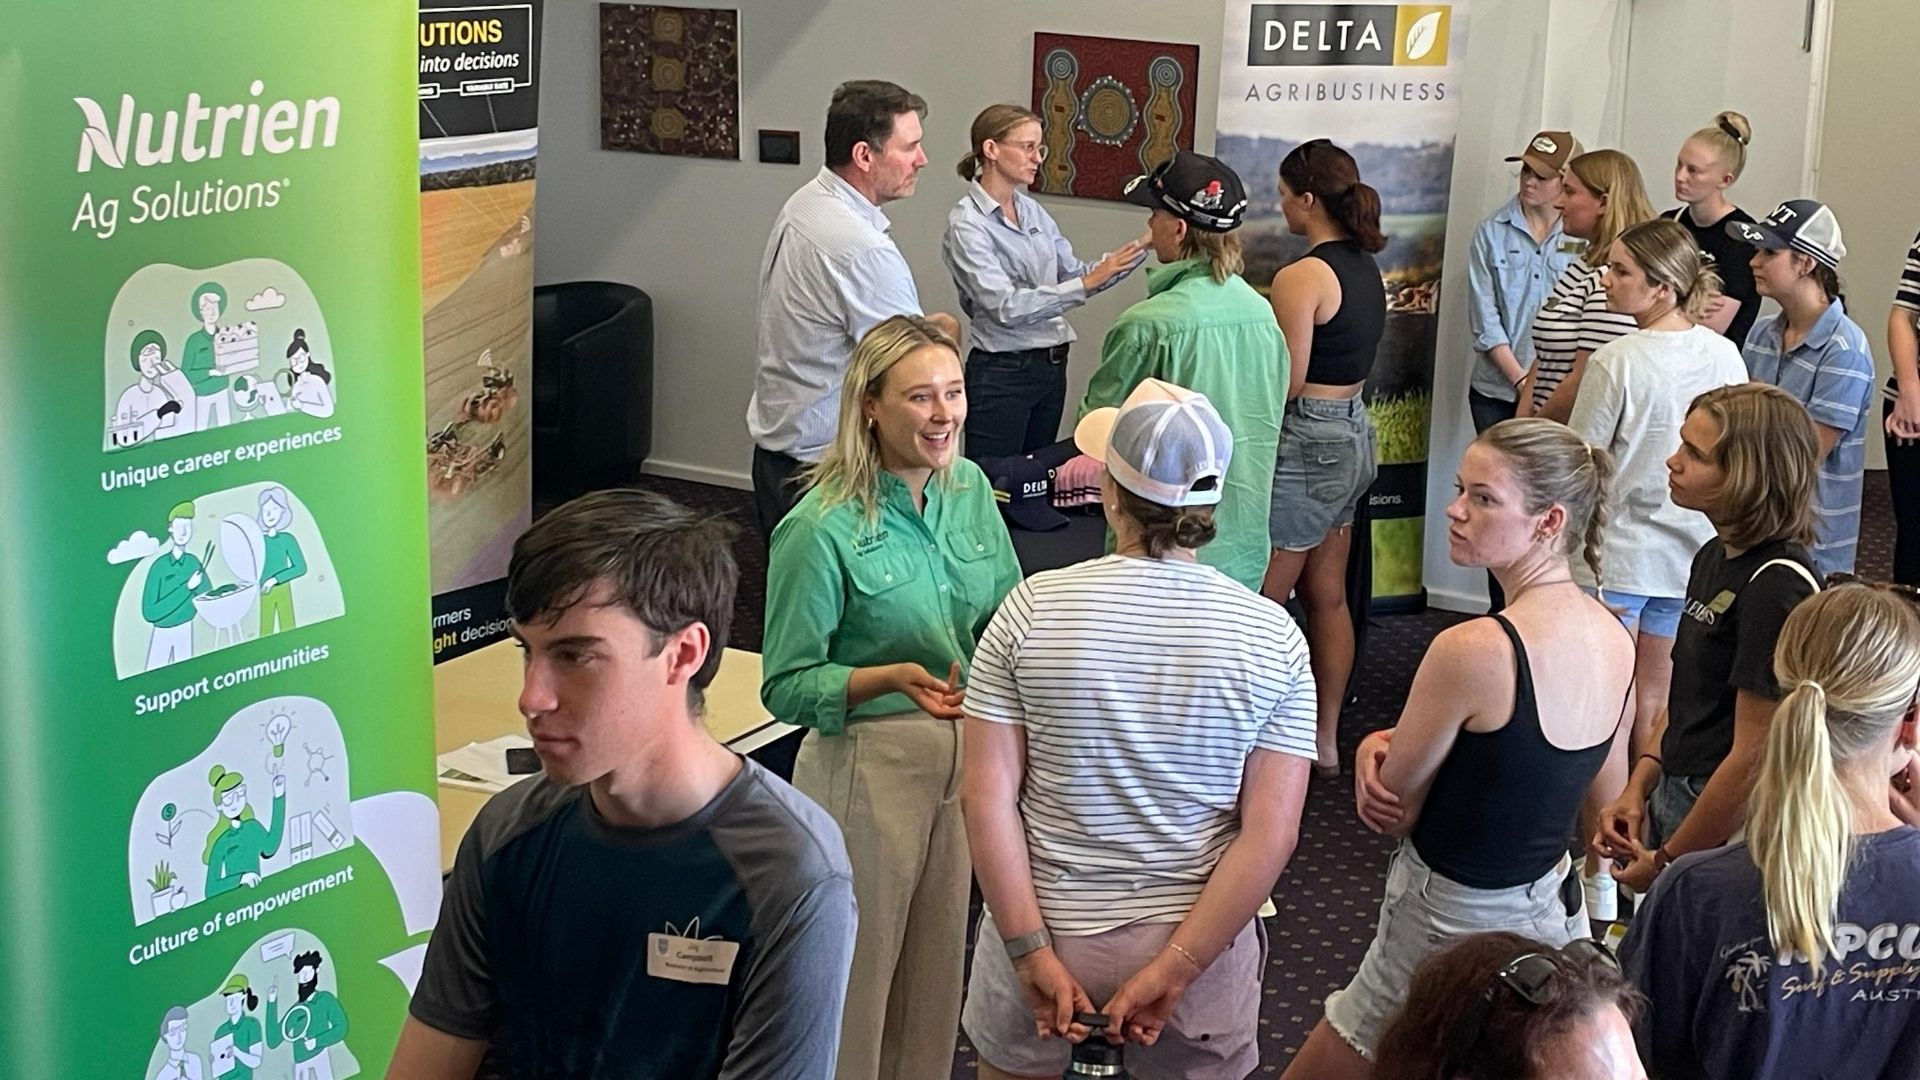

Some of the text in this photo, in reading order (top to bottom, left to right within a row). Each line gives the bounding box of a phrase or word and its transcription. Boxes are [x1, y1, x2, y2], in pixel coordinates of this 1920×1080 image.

[420, 19, 503, 47] UTIONS
[1264, 19, 1382, 51] DELTA
[420, 51, 520, 73] into decisions
[1245, 83, 1446, 102] AGRIBUSINESS
[73, 80, 341, 172] Nutrien
[72, 192, 119, 239] Ag
[101, 426, 343, 492] Unique career experiences
[433, 607, 472, 629] rmers
[434, 631, 457, 654] ght
[135, 644, 330, 715] Support communities
[129, 865, 355, 966] Culture of empowerment
[1831, 968, 1847, 985] &
